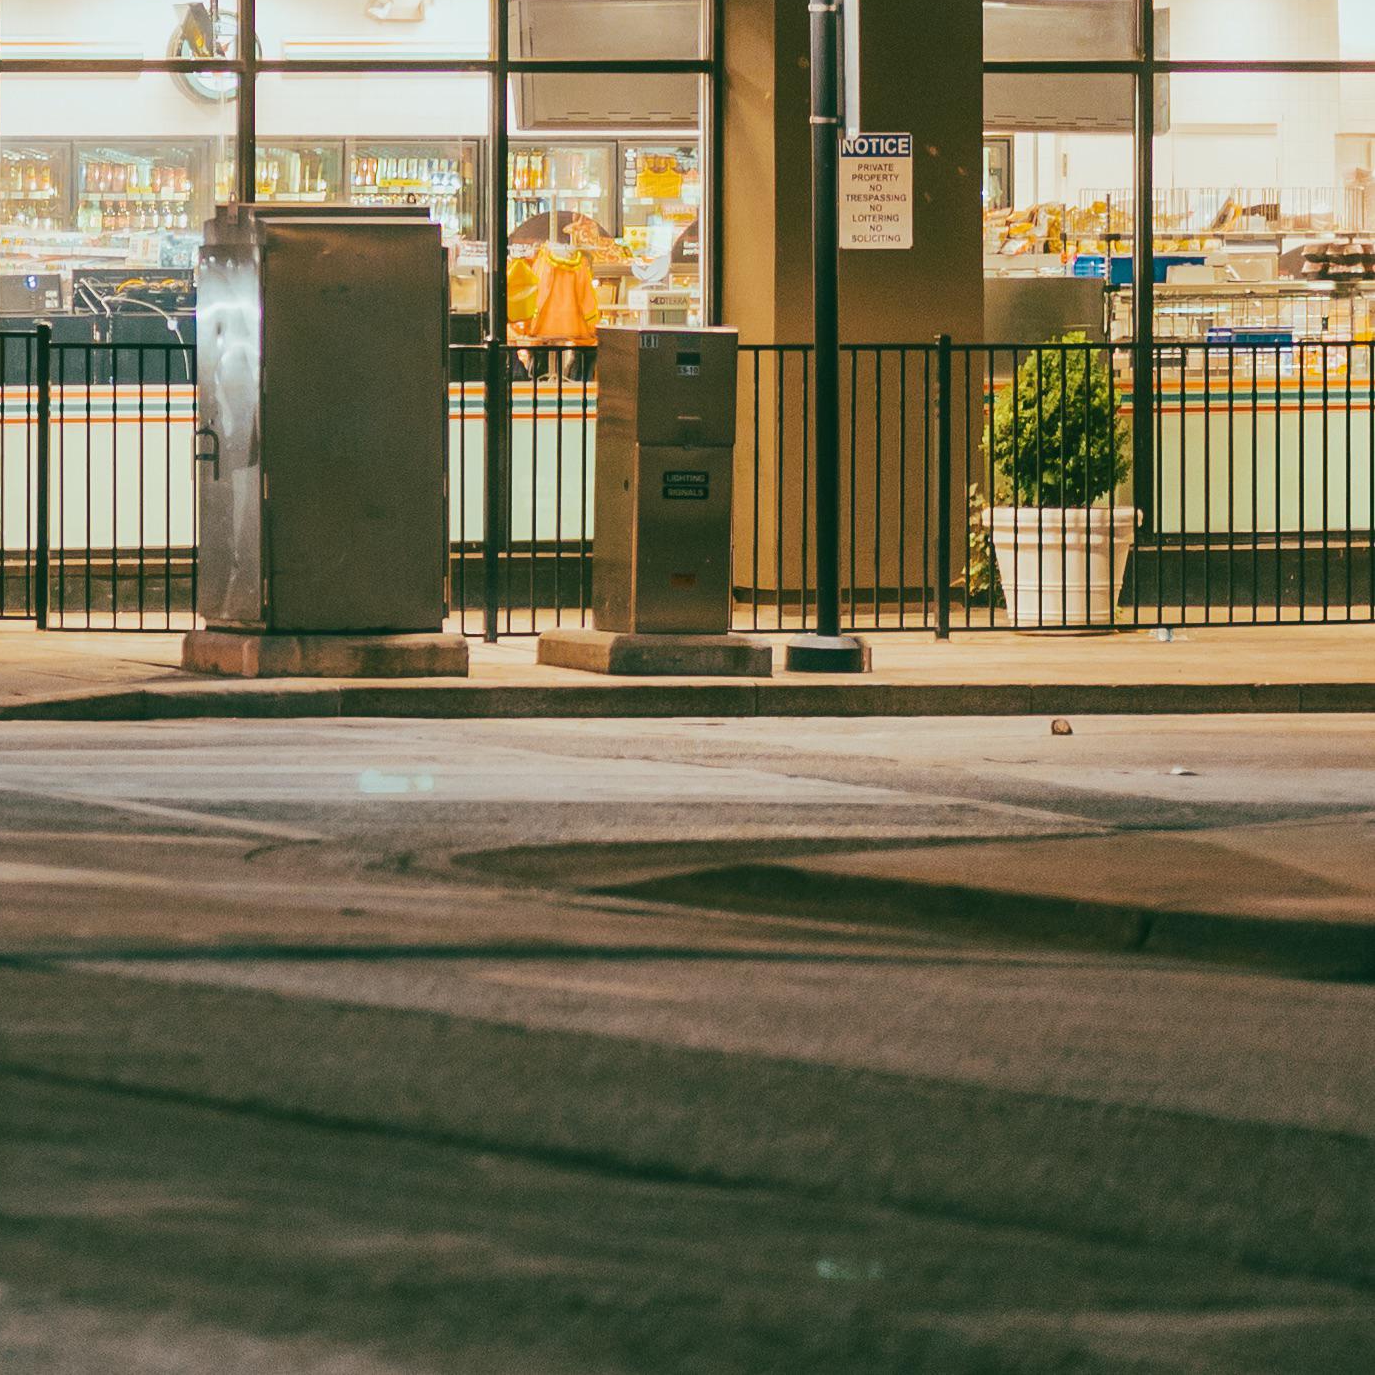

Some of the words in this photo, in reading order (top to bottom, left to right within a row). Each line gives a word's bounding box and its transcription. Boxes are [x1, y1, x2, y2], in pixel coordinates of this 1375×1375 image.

[842, 138, 909, 155] NOTICE
[857, 163, 895, 172] PRIVATE
[851, 173, 899, 182] PROPERTY
[869, 184, 883, 192] NO
[846, 194, 907, 202] TRESPASSING
[869, 204, 883, 212] NO
[852, 214, 899, 222] LOITERING
[869, 224, 882, 232] NO
[851, 234, 901, 243] SOLICITING
[666, 474, 705, 483] LIGHTING
